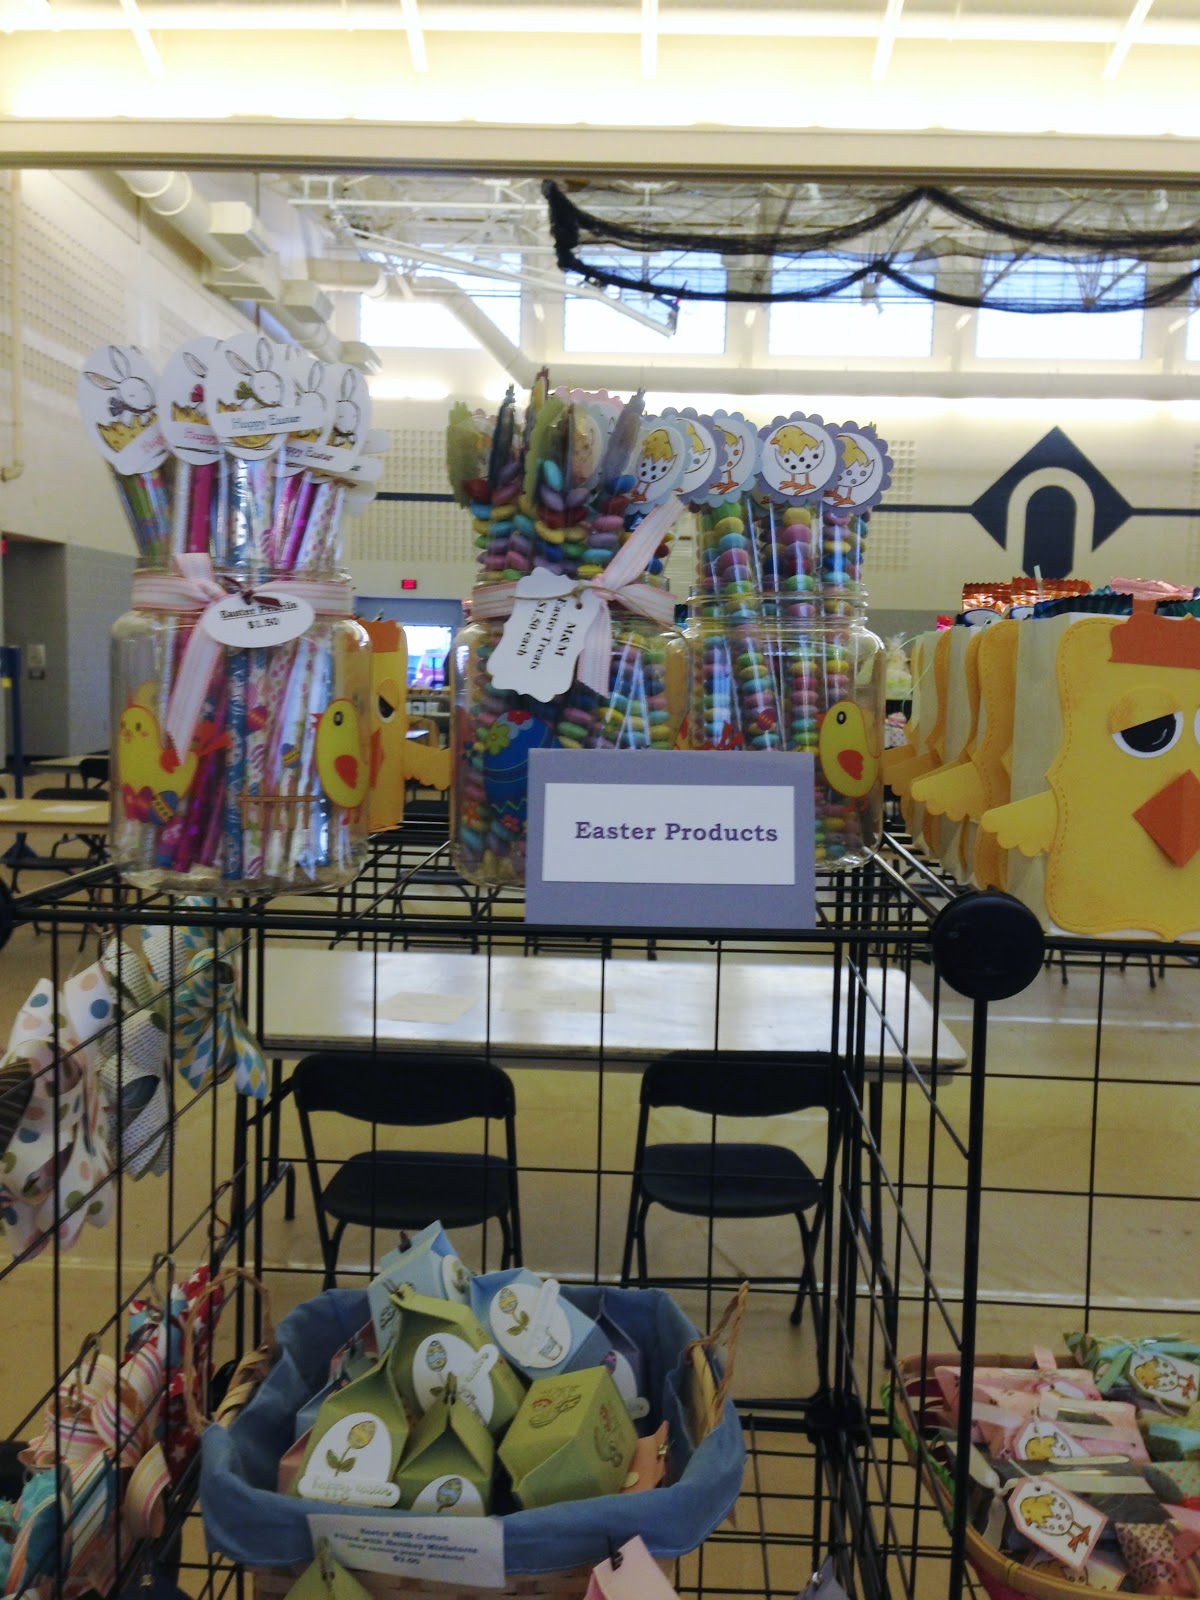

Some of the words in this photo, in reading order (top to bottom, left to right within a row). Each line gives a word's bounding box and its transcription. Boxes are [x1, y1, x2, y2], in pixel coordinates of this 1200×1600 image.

[231, 417, 266, 431] Happy
[546, 598, 567, 633] Easter
[516, 631, 532, 656] each
[530, 636, 551, 670] Treats
[555, 622, 577, 657] M&M
[574, 821, 656, 841] Easter
[665, 822, 778, 843] Products
